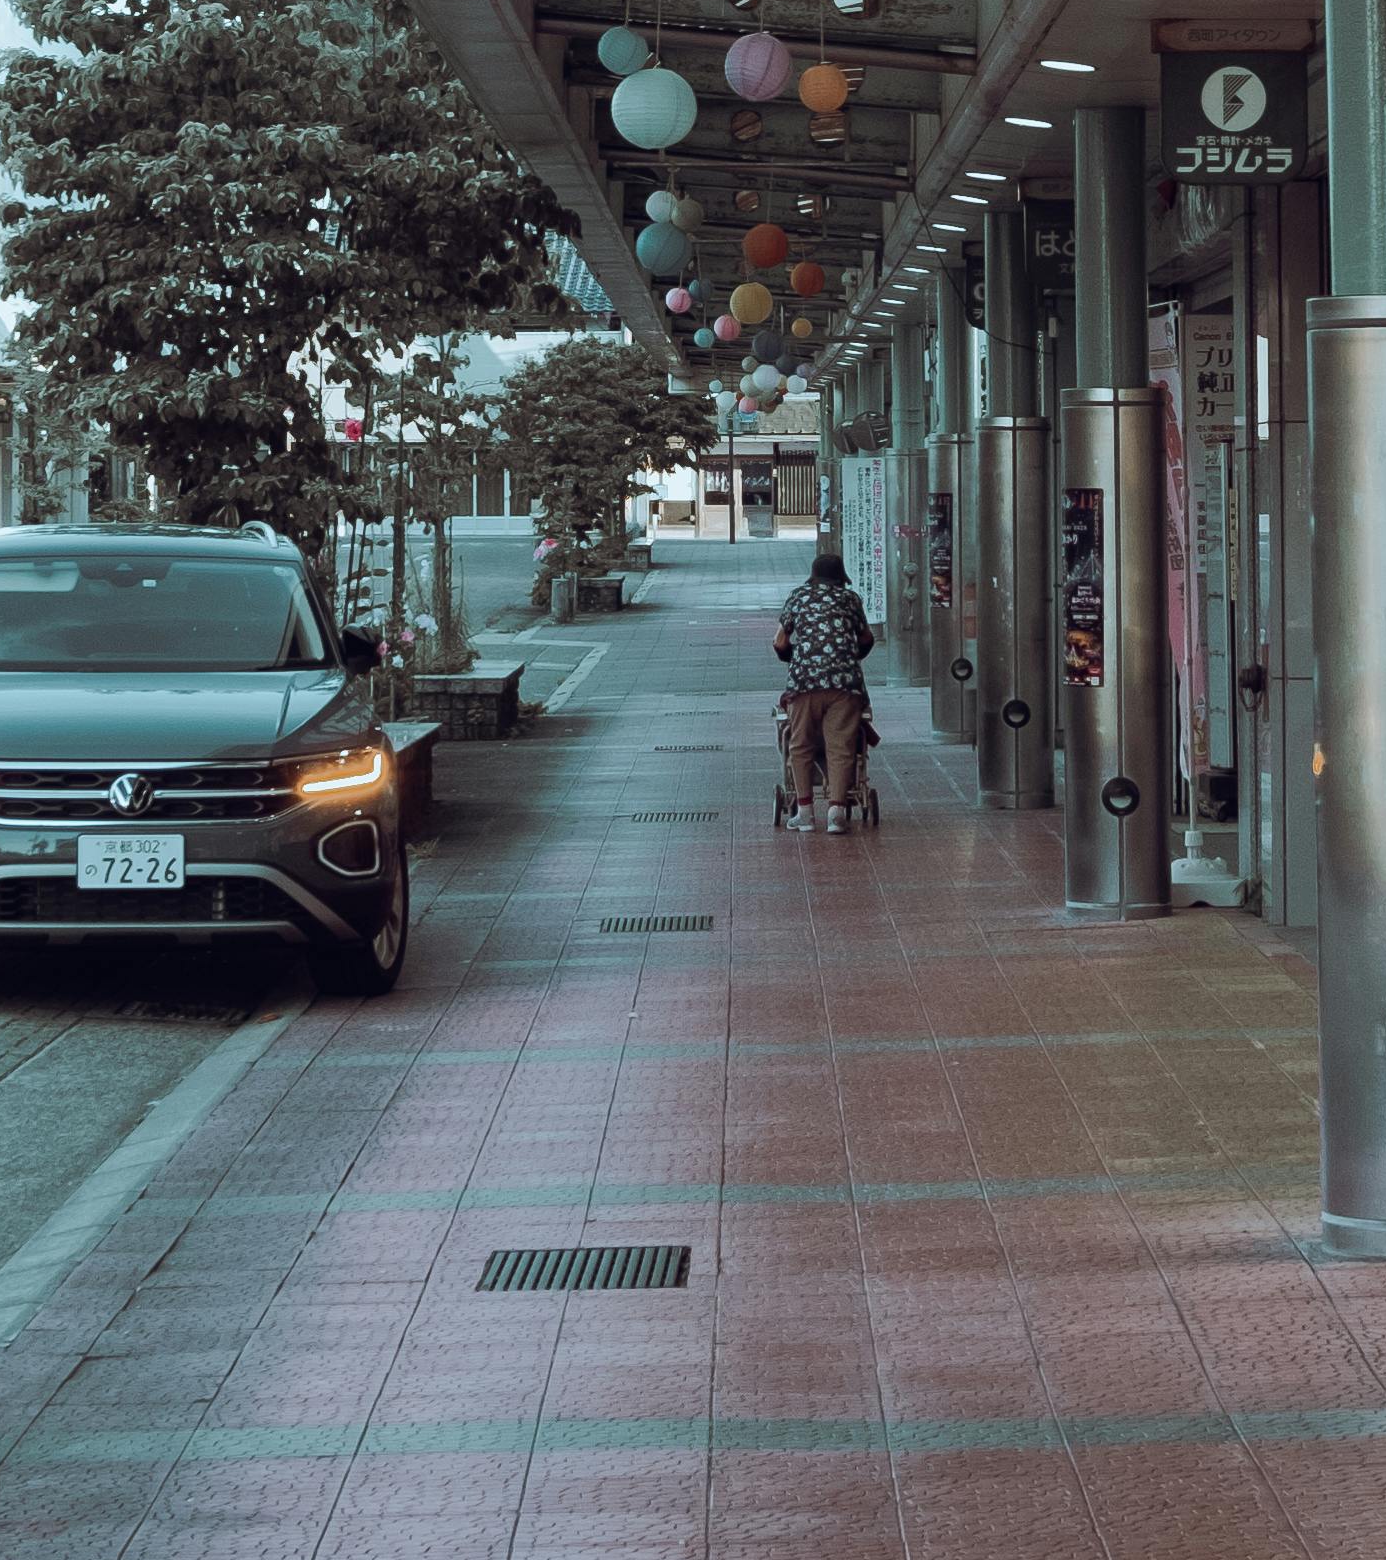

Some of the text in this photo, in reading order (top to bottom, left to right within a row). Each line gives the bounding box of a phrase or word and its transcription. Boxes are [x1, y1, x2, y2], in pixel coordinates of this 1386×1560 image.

[1176, 147, 1293, 173] フジムラ
[102, 857, 178, 884] 72-26
